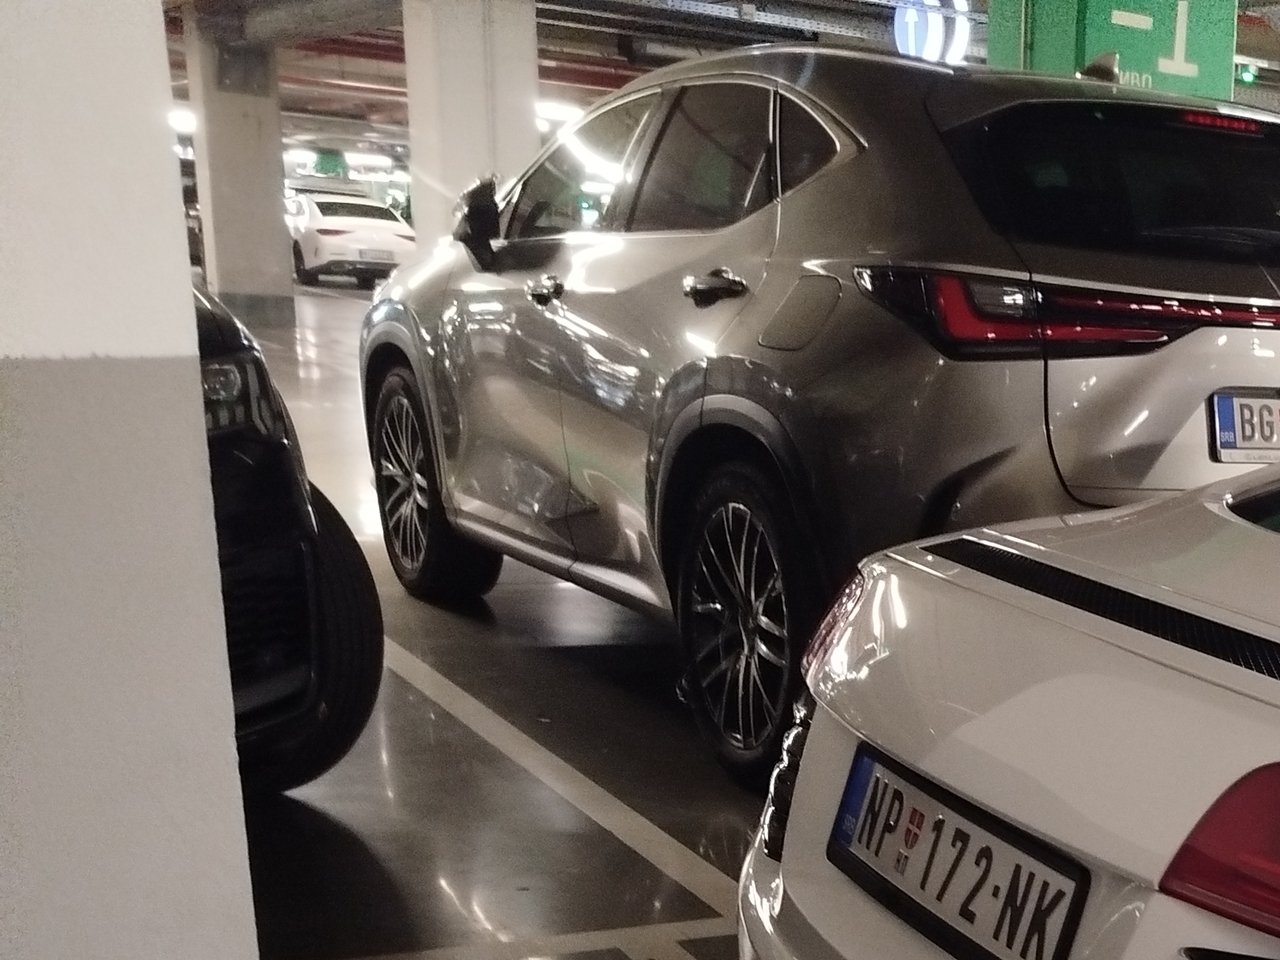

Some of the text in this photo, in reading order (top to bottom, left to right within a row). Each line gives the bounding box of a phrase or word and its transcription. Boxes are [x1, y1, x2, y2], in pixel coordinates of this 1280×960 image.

[1109, 0, 1199, 78] -1
[1239, 403, 1276, 443] BG
[857, 773, 904, 857] NP
